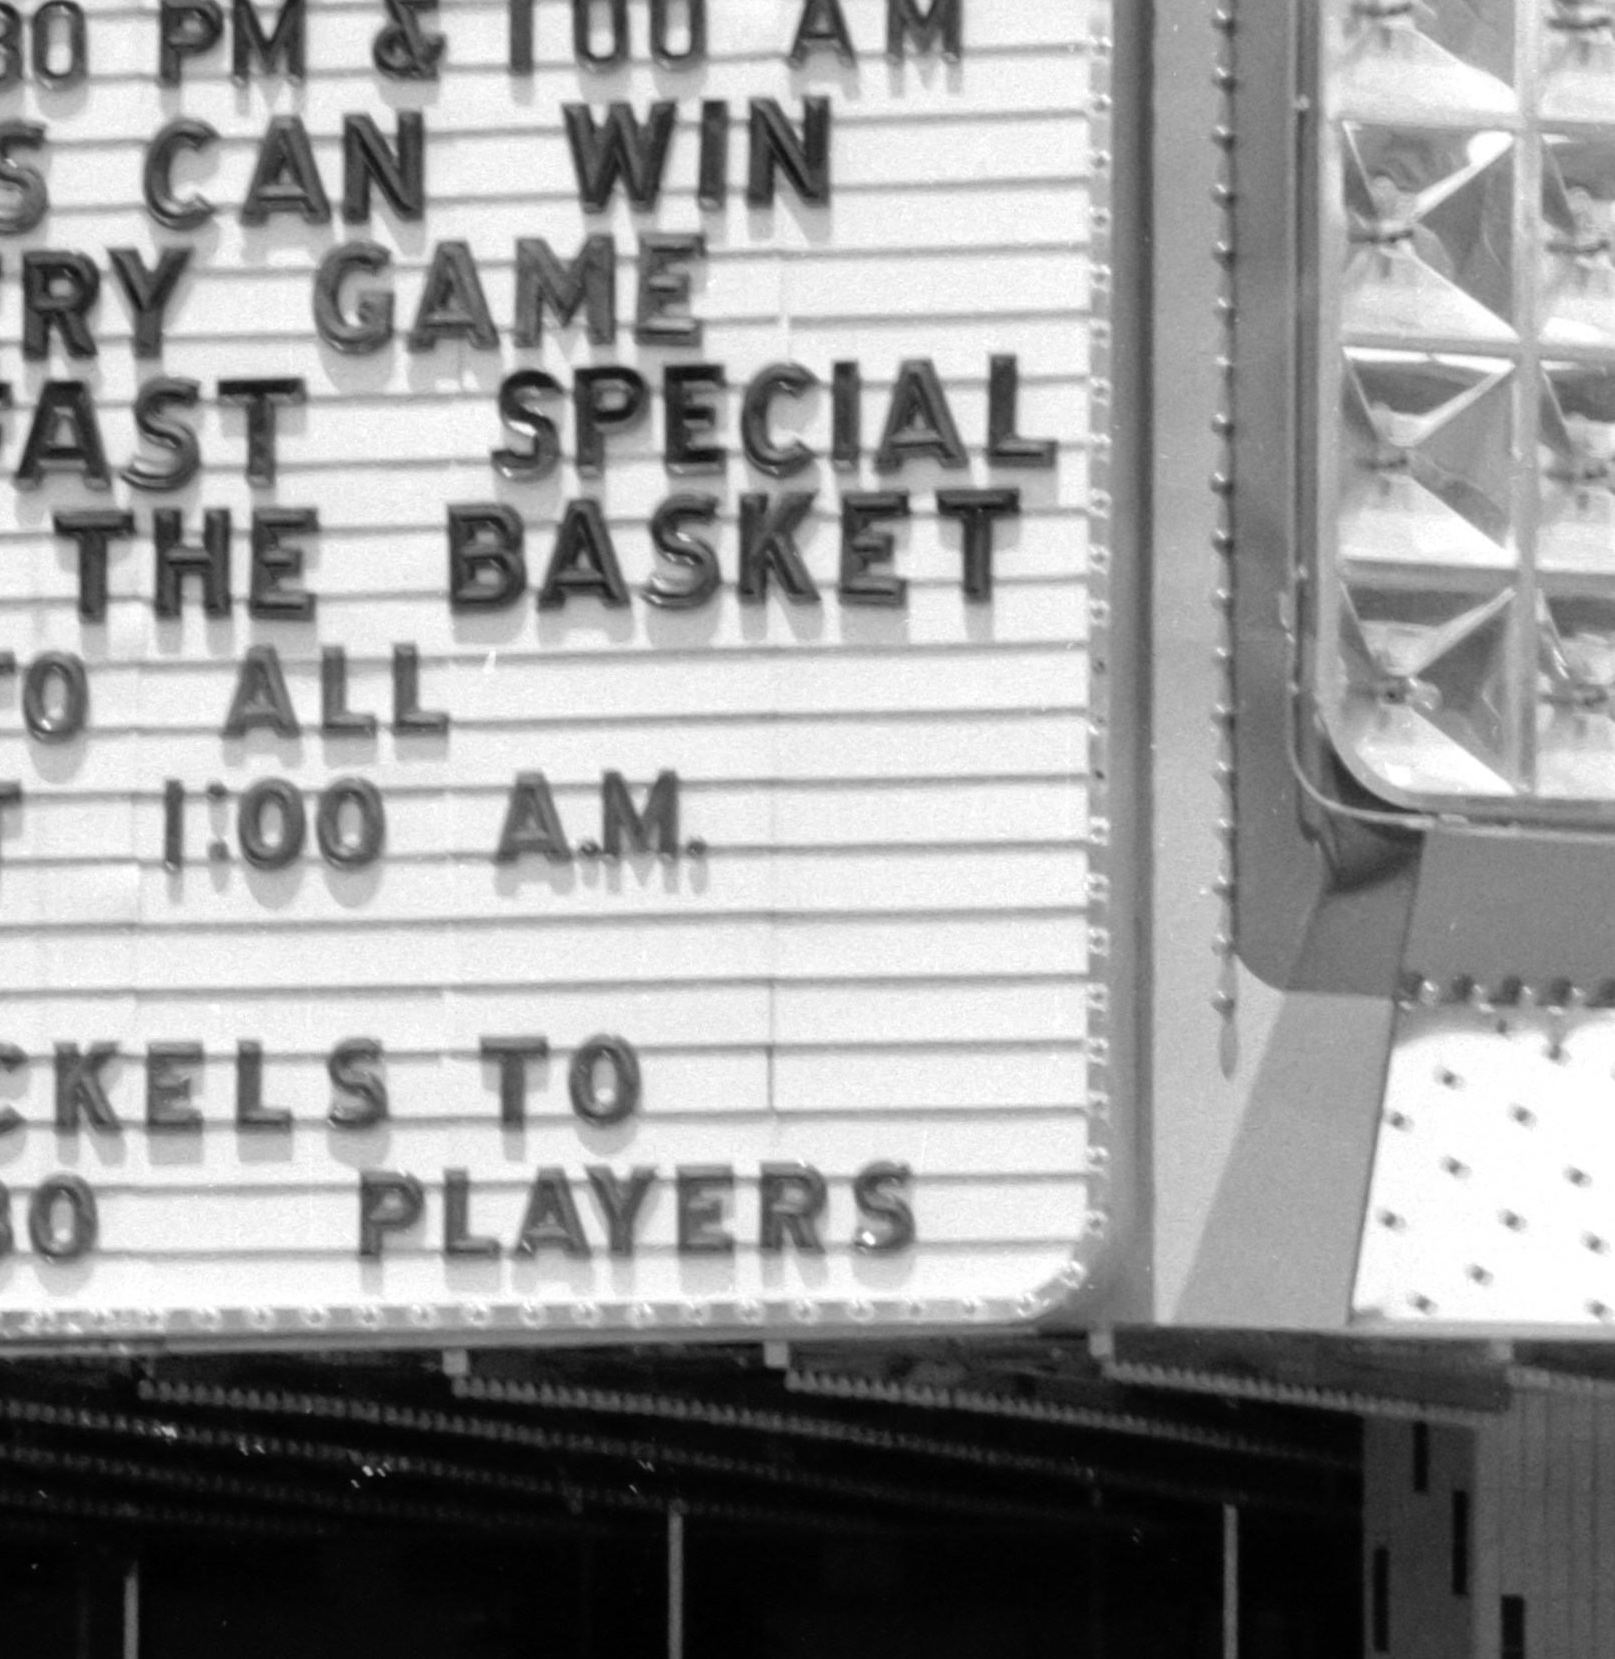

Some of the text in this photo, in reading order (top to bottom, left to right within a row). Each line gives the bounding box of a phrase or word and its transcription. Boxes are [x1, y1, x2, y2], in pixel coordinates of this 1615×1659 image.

[141, 109, 429, 235] CAN
[561, 95, 834, 217] WIN
[312, 232, 711, 359] GAME
[488, 354, 1060, 486] SPECIAL
[50, 505, 324, 626] THE
[444, 485, 1025, 618] BASKET
[220, 645, 452, 741] ALL
[161, 779, 386, 874] 1:00
[492, 770, 709, 867] A.M.
[478, 1038, 642, 1133] TO
[356, 1165, 916, 1263] PLAYERS
